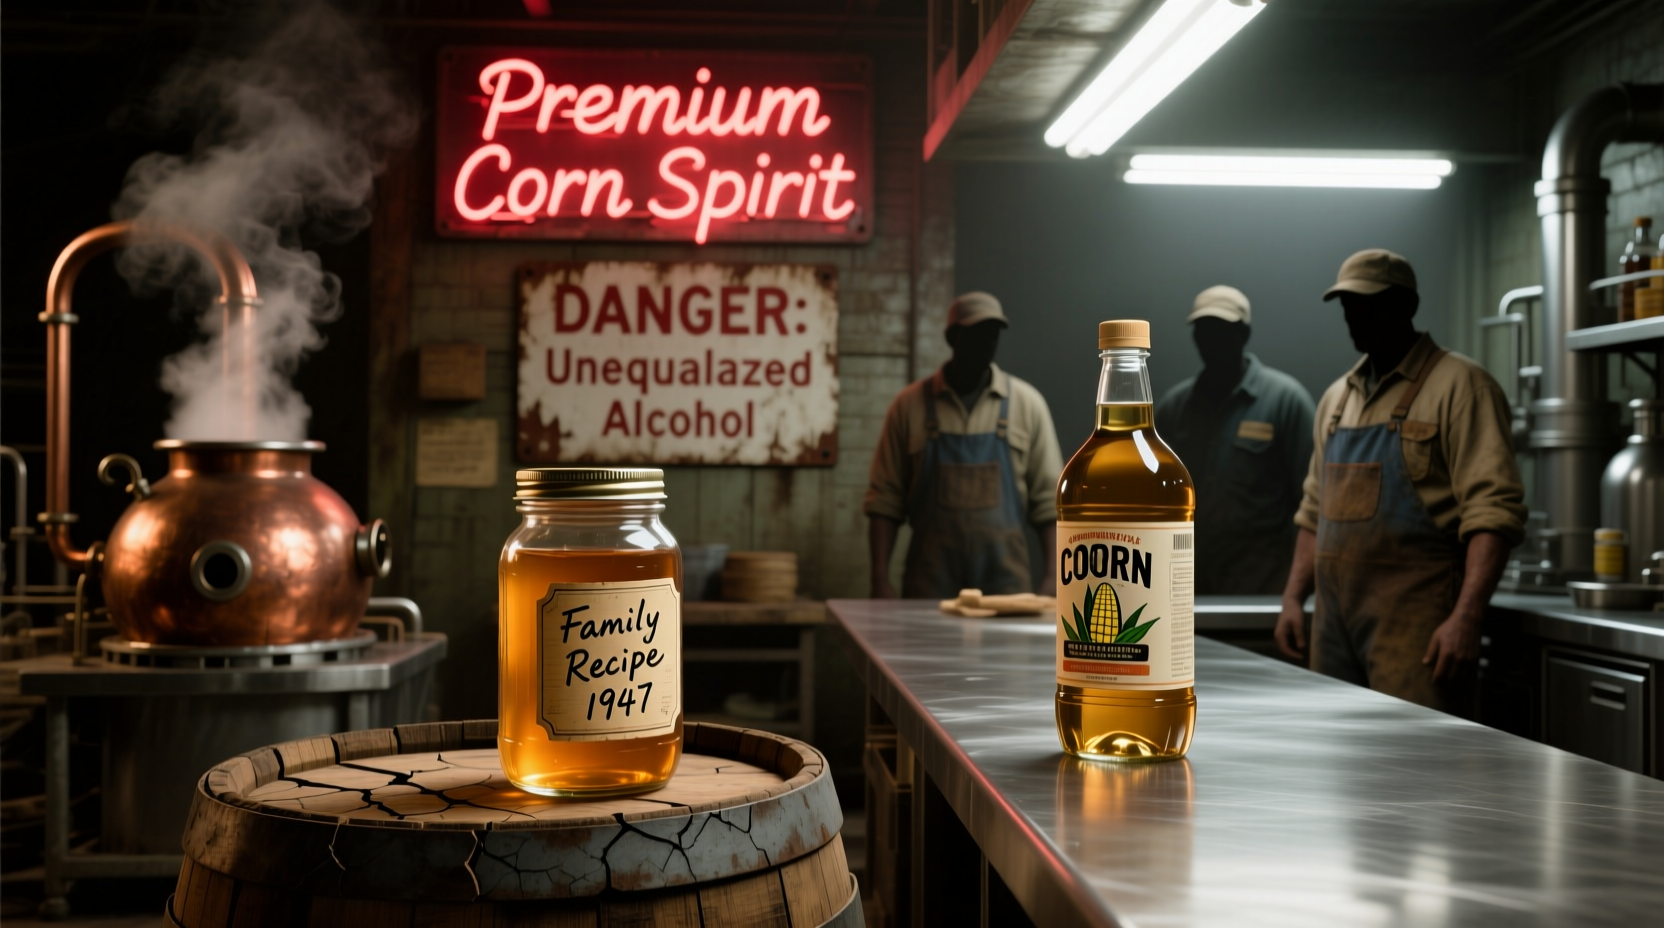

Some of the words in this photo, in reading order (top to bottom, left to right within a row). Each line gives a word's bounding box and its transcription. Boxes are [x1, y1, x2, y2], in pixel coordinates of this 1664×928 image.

[479, 58, 831, 141] Premium
[454, 144, 633, 220] Corn
[647, 146, 856, 245] Spirit
[554, 285, 807, 335] DANGER:
[545, 347, 812, 395] Unequalazed
[602, 400, 755, 438] Alcohol
[1061, 543, 1152, 589] COORN
[560, 598, 660, 644] Family
[566, 648, 664, 686] Recipe
[586, 682, 653, 721] 1947
